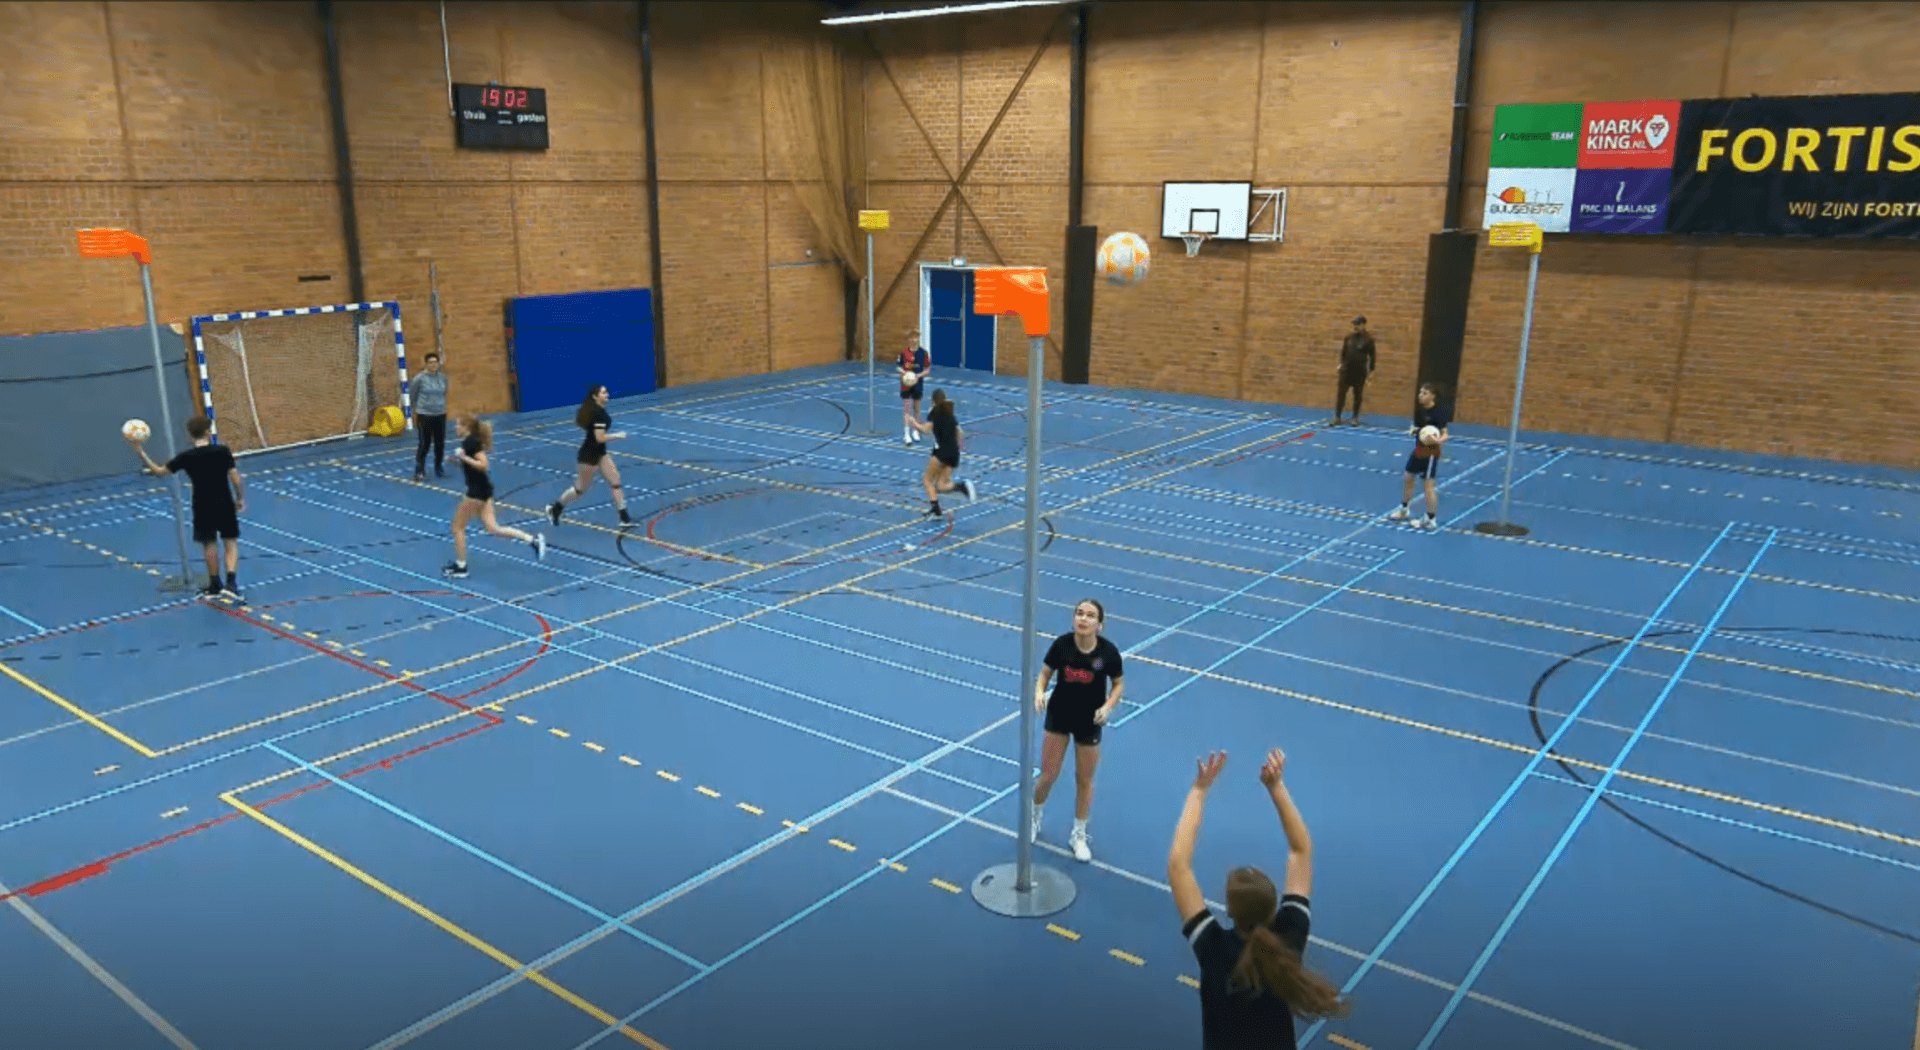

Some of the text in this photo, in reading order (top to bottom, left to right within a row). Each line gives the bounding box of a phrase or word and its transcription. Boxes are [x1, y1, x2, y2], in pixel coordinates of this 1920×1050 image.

[1588, 118, 1643, 134] MARK
[1696, 125, 1920, 172] FORTIS
[1580, 203, 1658, 213] PMC IN BALANS
[1788, 201, 1817, 220] WIJ
[1821, 201, 1859, 220] ZIJN
